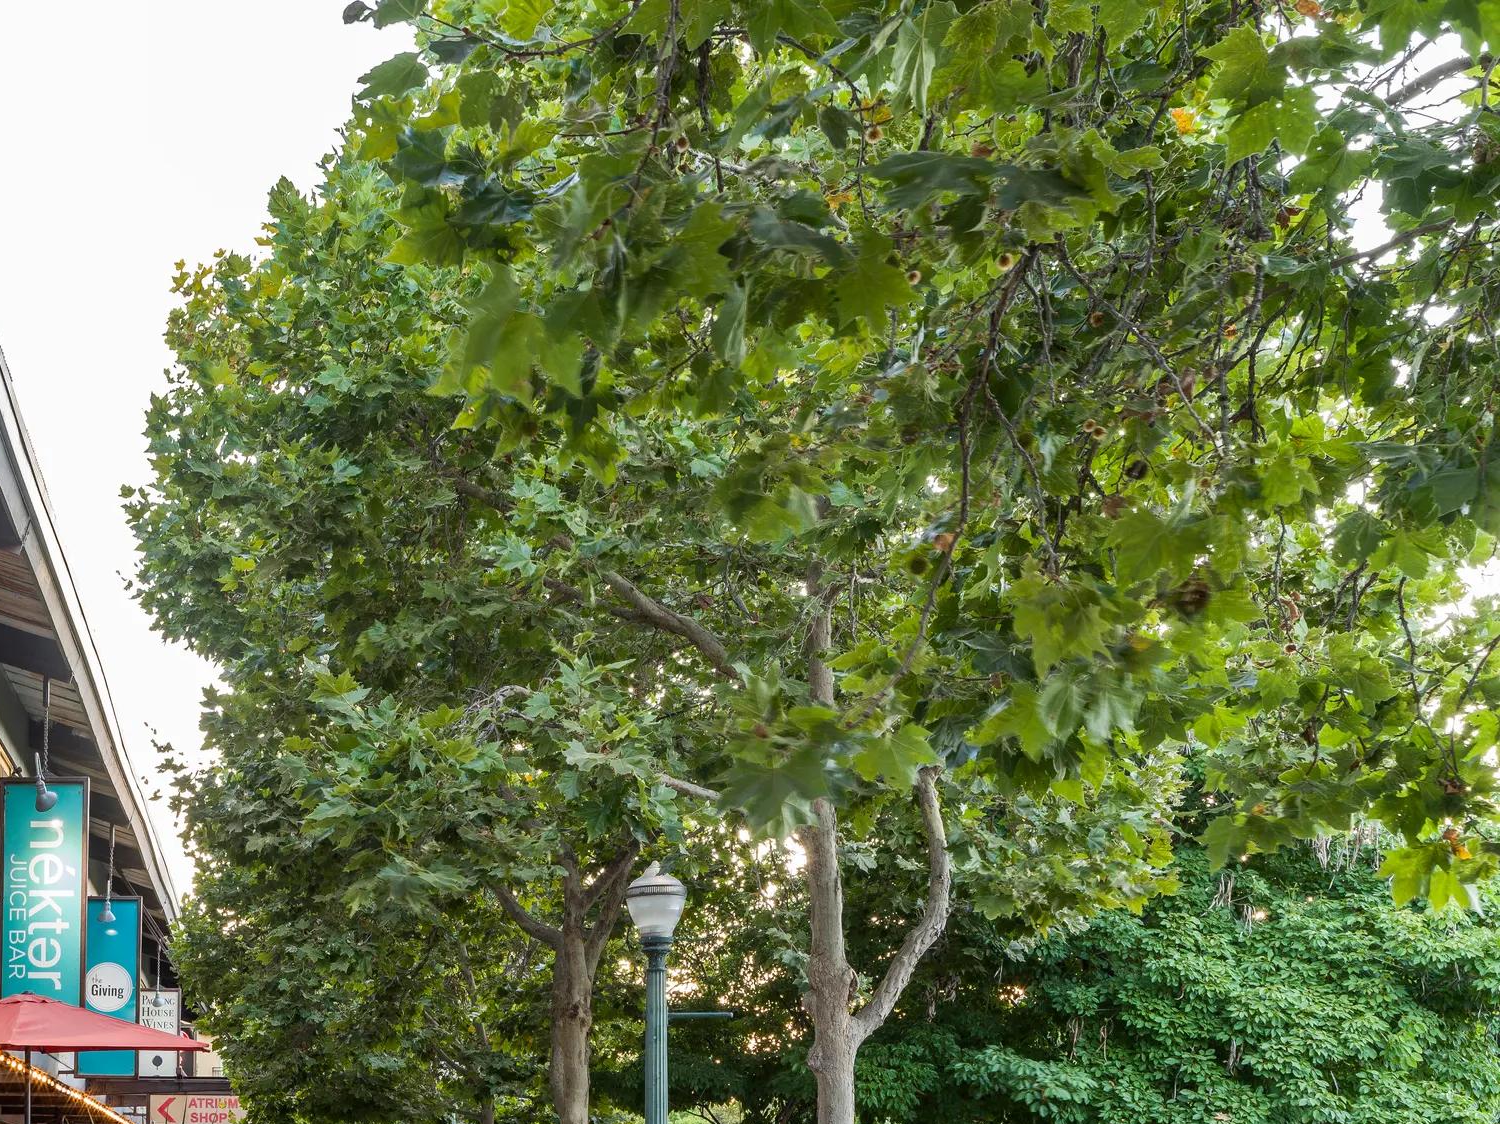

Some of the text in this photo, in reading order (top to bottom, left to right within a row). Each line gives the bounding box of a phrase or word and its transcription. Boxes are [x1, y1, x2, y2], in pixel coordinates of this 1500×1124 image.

[8, 853, 28, 980] JUICE BAR
[92, 973, 103, 984] the
[91, 984, 125, 999] Giving
[142, 1007, 175, 1017] HOUSE
[141, 1019, 175, 1030] WINES
[190, 1112, 228, 1123] SHOP
